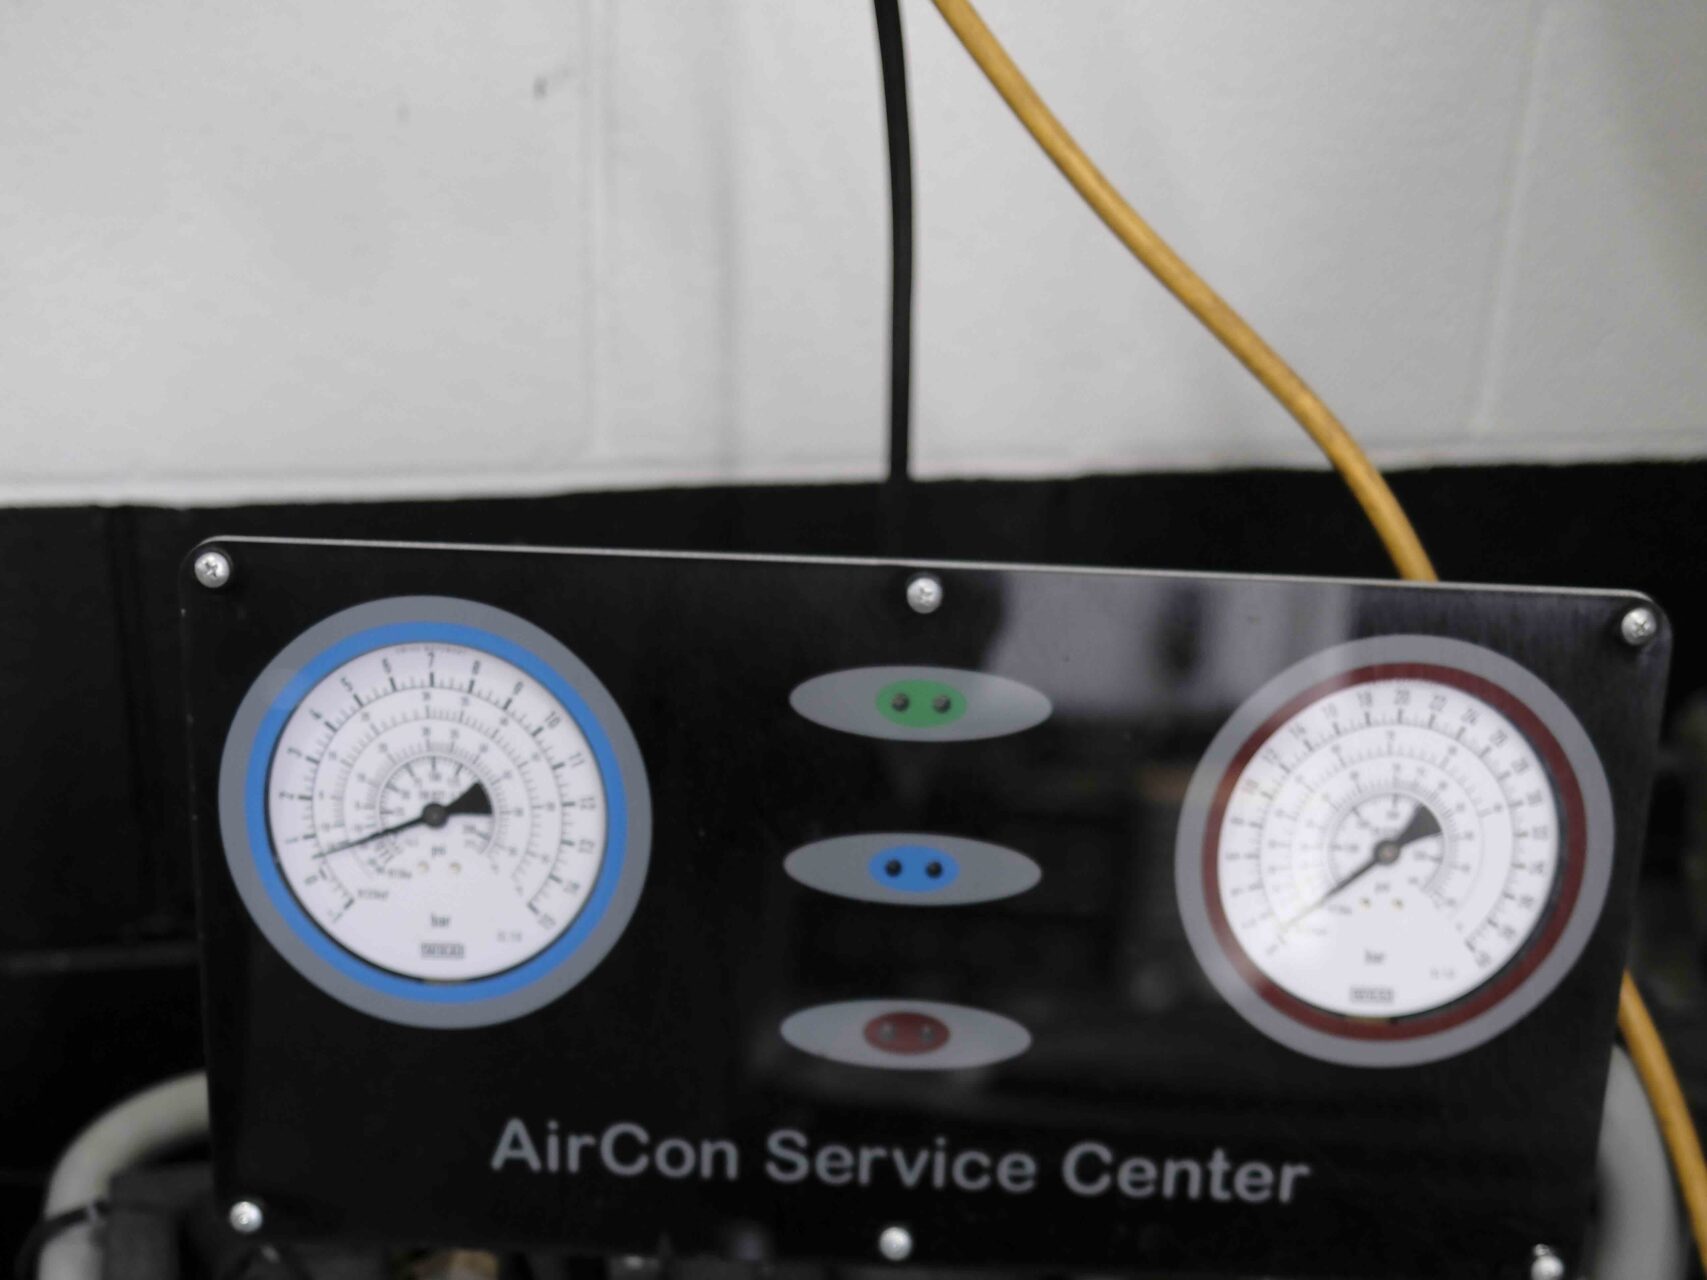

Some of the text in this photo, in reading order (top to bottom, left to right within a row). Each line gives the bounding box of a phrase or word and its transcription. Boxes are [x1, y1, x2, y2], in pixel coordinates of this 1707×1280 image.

[427, 651, 435, 669] 7
[544, 711, 561, 729] 10
[431, 913, 451, 928] bar
[492, 1117, 1312, 1207] AirCon Service Center
